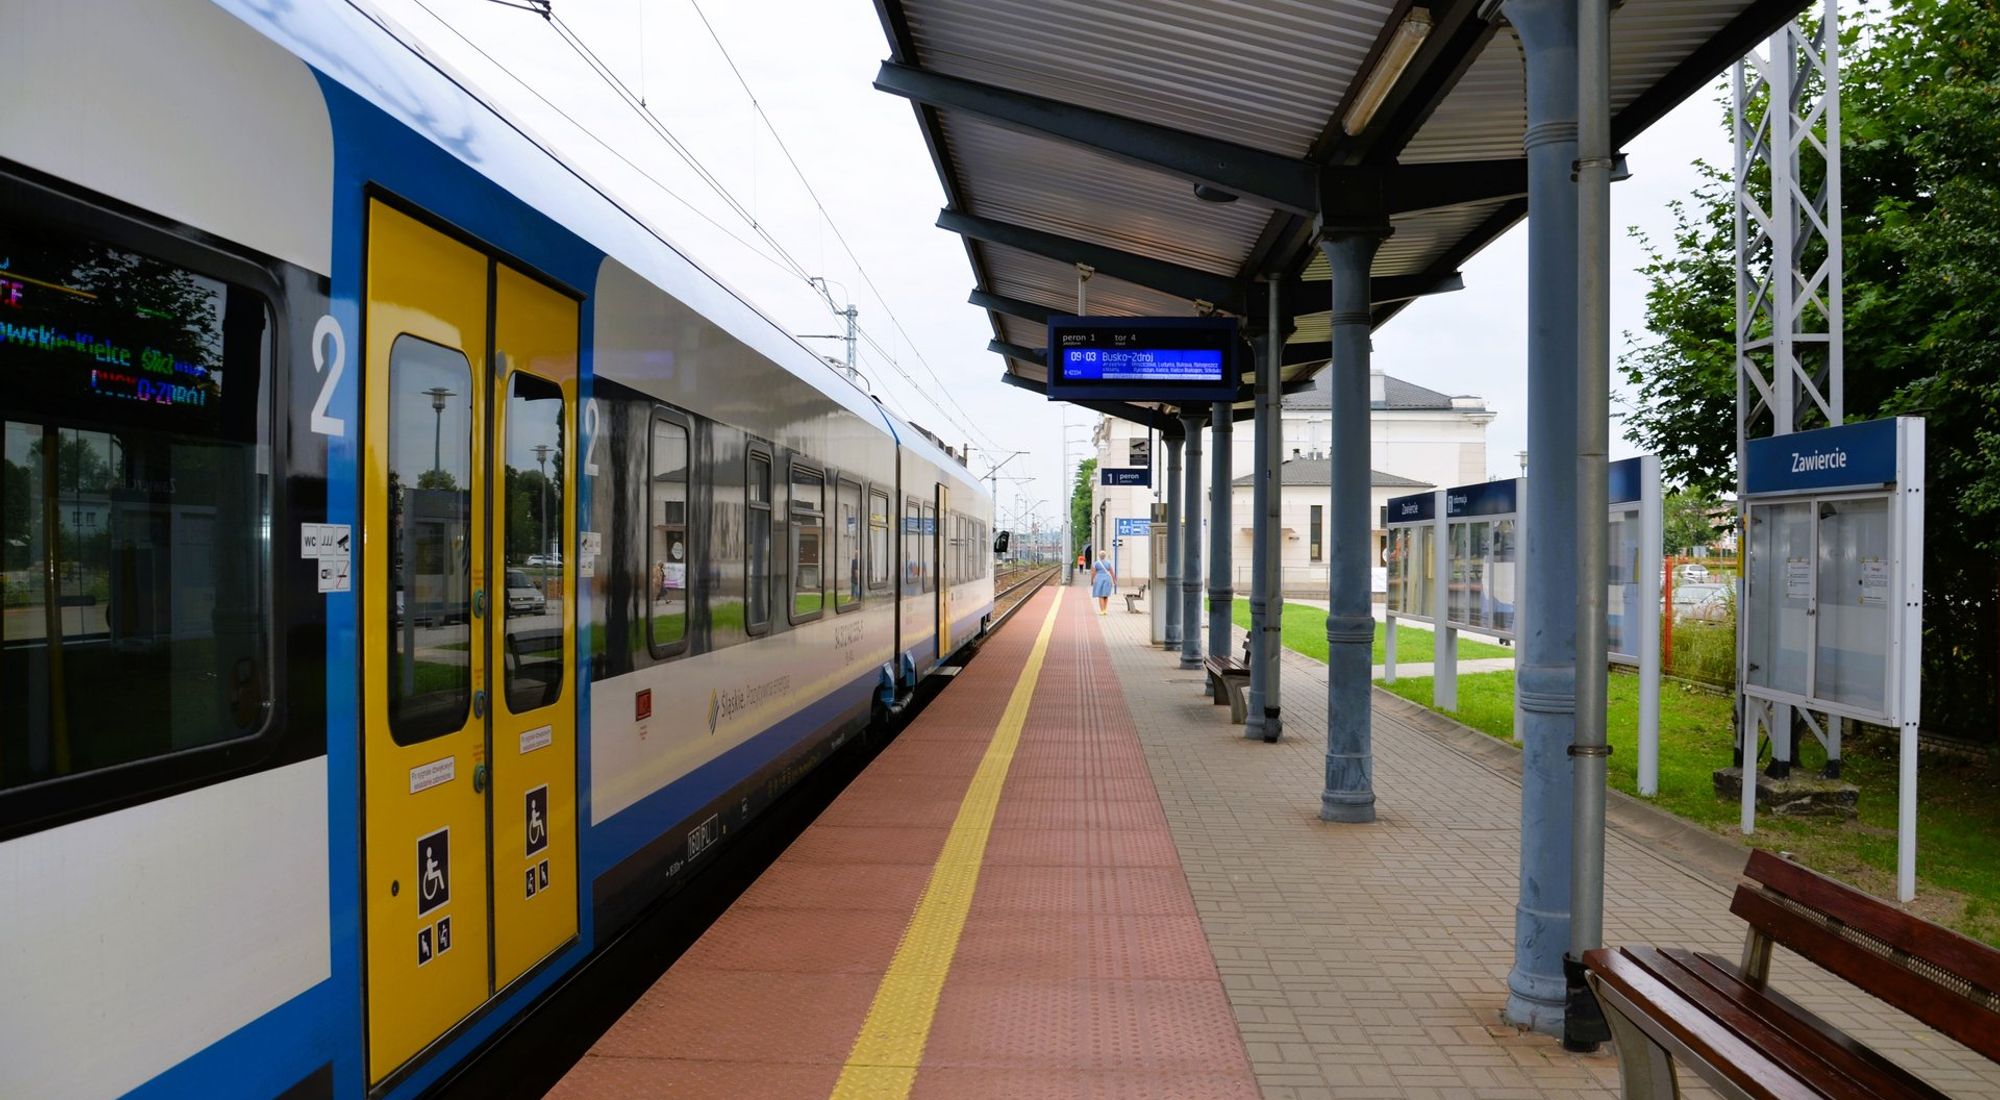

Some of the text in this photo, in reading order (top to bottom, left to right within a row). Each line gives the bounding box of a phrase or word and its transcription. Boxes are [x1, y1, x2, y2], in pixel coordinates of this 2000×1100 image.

[1062, 333, 1096, 342] peron 1
[311, 314, 346, 437] 2
[584, 398, 600, 476] 2
[1791, 447, 1847, 473] Zawiercie
[1107, 473, 1113, 484] 1
[1119, 473, 1140, 481] peron
[304, 536, 317, 547] WC
